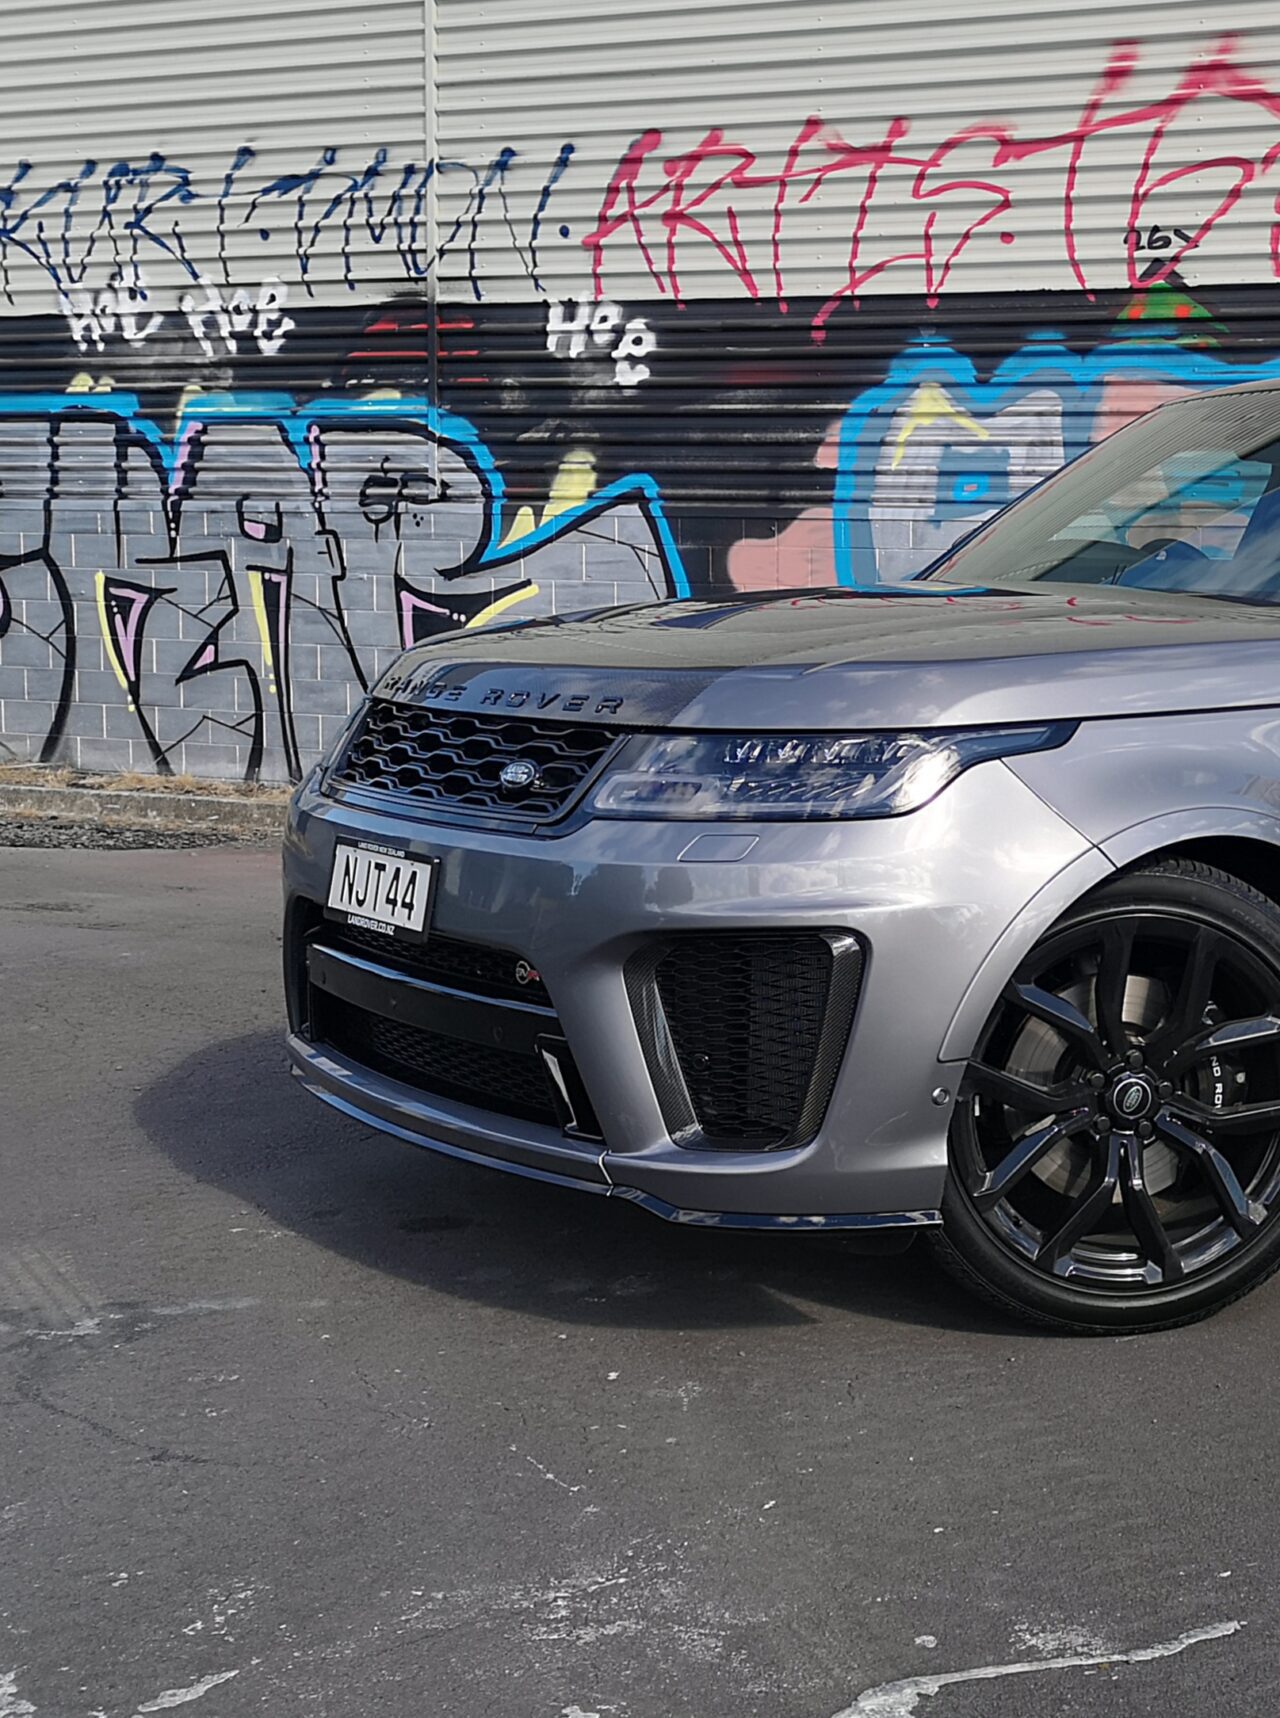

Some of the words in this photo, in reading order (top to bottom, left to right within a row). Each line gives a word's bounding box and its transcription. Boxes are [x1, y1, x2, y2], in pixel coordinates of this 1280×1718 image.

[383, 675, 468, 702] RANGE
[480, 688, 625, 715] ROVER
[340, 854, 418, 921] NJT44
